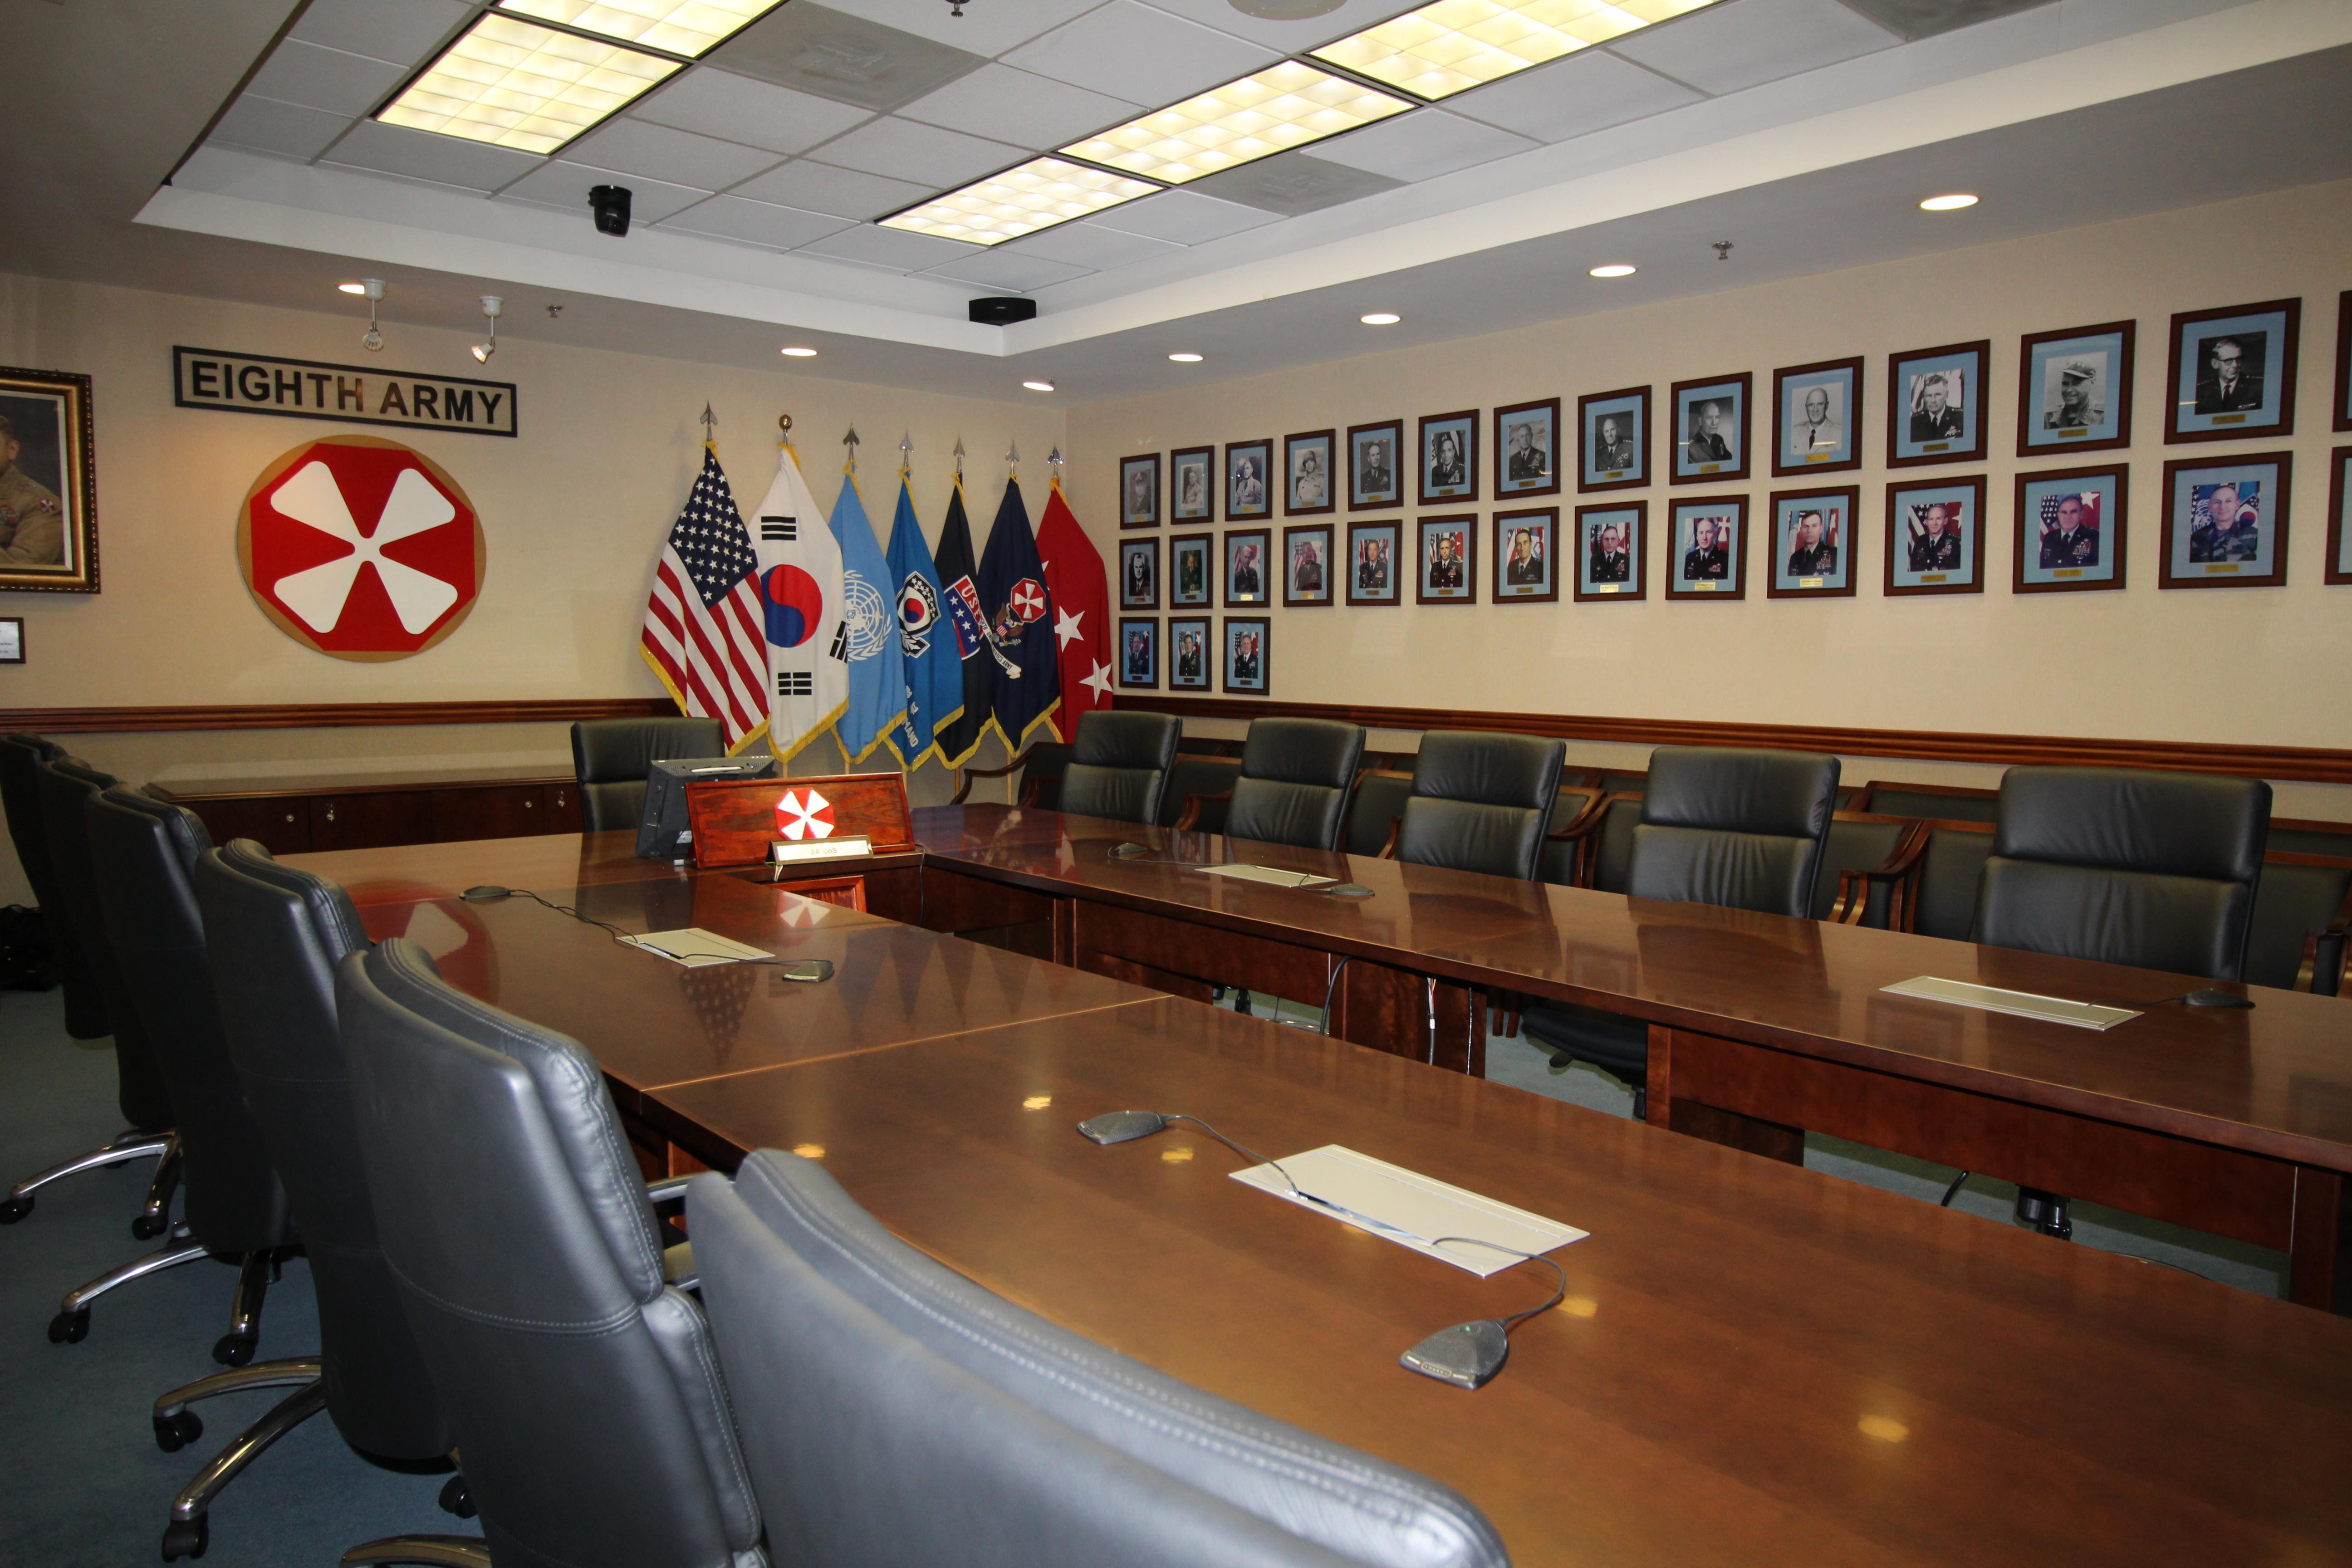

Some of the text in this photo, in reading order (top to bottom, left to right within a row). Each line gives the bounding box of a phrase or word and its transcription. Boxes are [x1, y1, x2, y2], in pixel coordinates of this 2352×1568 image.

[192, 360, 503, 424] EIGHTH ARMY
[1003, 660, 1013, 670] ARMY
